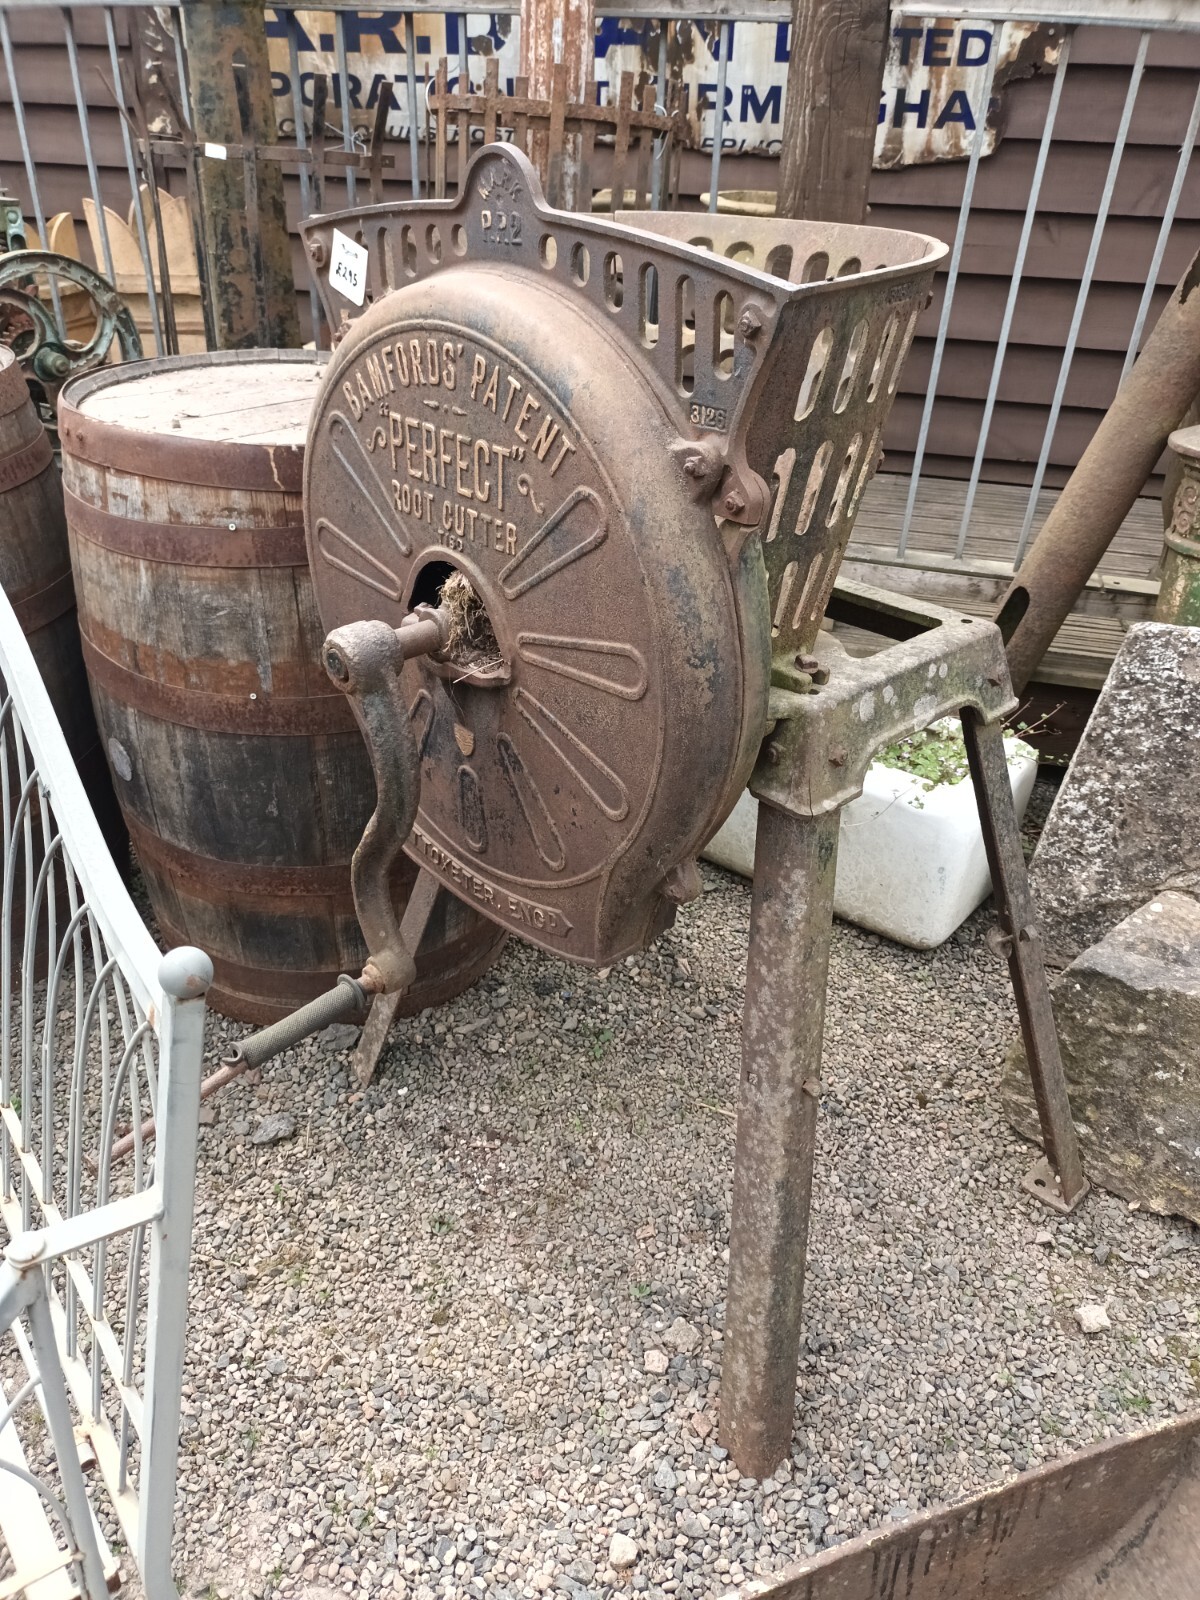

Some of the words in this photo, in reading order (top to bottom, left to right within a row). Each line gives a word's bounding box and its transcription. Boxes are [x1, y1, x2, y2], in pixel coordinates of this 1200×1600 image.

[470, 353, 577, 477] PATENT
[391, 478, 434, 524] ROOT
[442, 500, 517, 556] CUTTER
